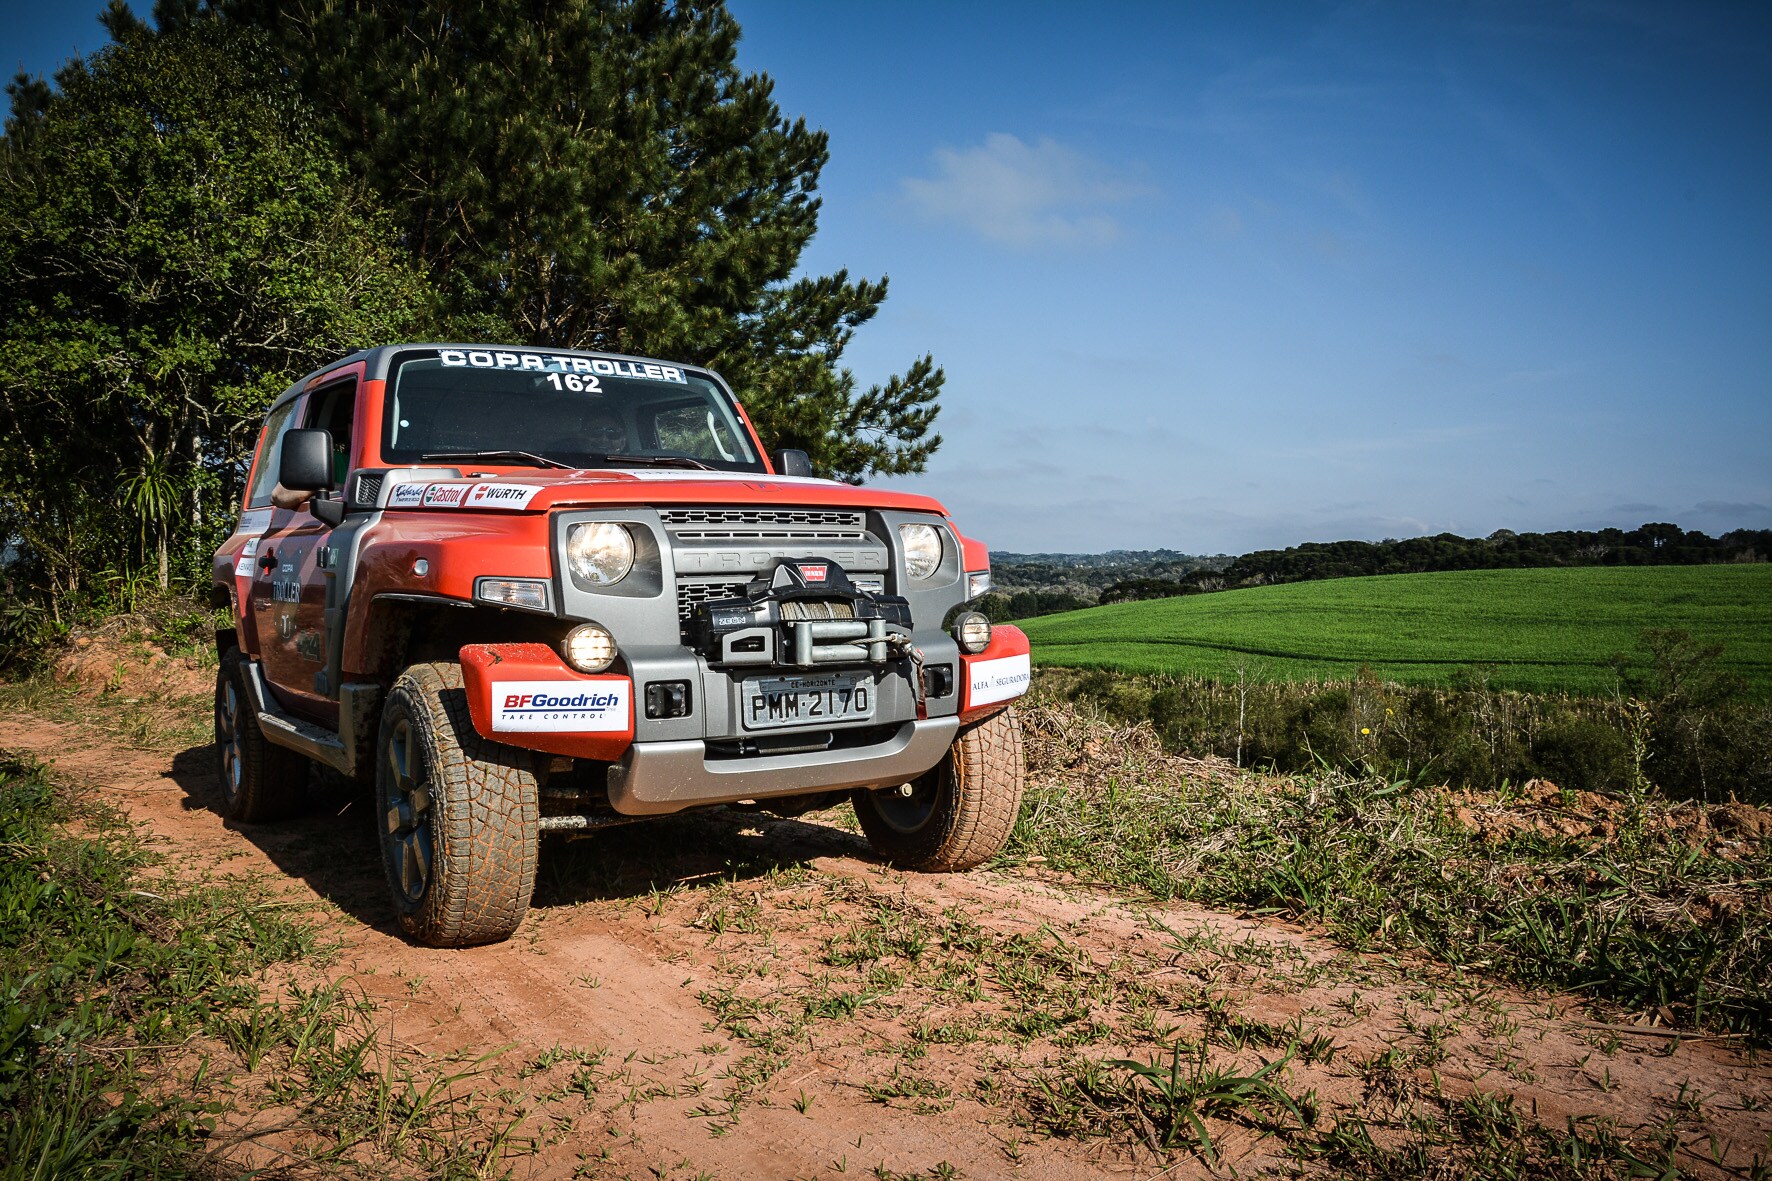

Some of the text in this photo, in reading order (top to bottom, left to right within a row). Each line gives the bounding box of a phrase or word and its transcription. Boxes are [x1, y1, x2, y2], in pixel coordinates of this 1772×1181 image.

[441, 350, 682, 382] COPA TROLLER
[546, 372, 603, 394] 162
[432, 486, 463, 502] Castrol
[718, 616, 746, 626] ZEON
[790, 679, 836, 689] CE-HORIZONTE
[972, 672, 1030, 691] ALFA SEGURADORA
[503, 693, 619, 708] BFGoodrich
[543, 712, 604, 720] CONTROL
